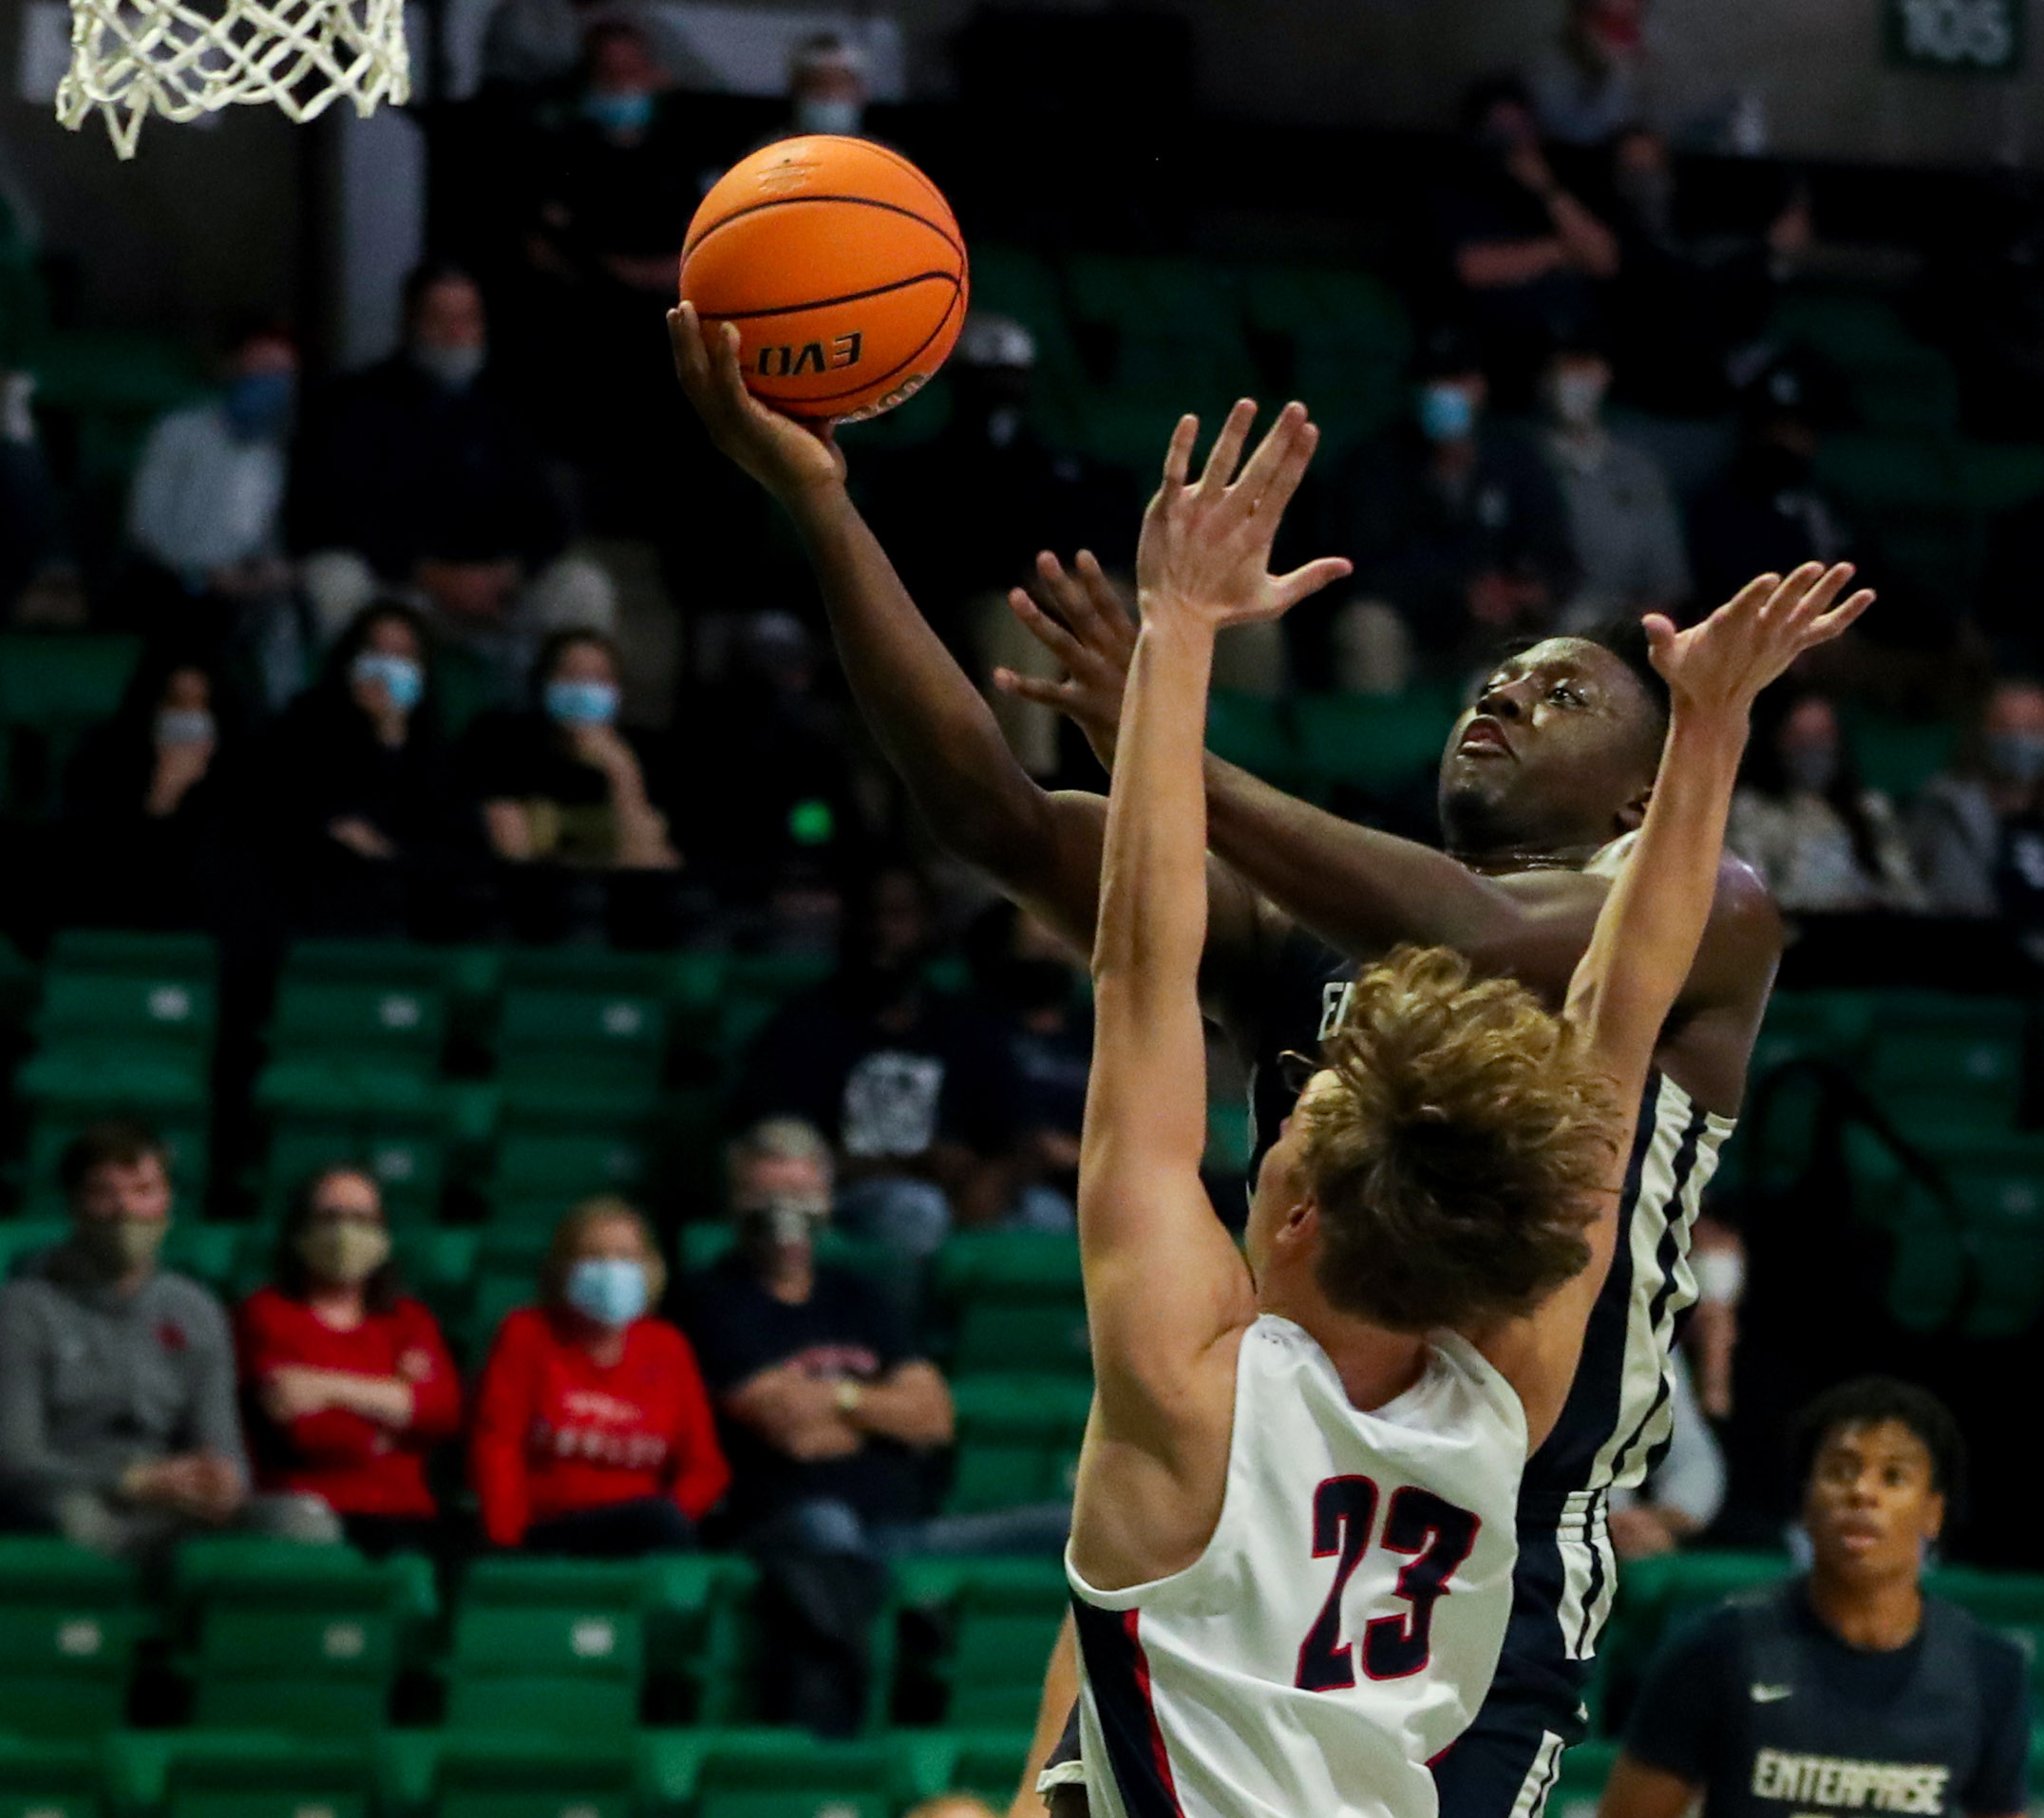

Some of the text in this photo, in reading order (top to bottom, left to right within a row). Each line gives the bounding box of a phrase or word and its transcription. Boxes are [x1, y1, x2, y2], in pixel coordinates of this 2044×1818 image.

[757, 331, 862, 375] EVO
[1295, 1474, 1482, 1693] 23
[1752, 1749, 1949, 1815] ENTERPRISE
